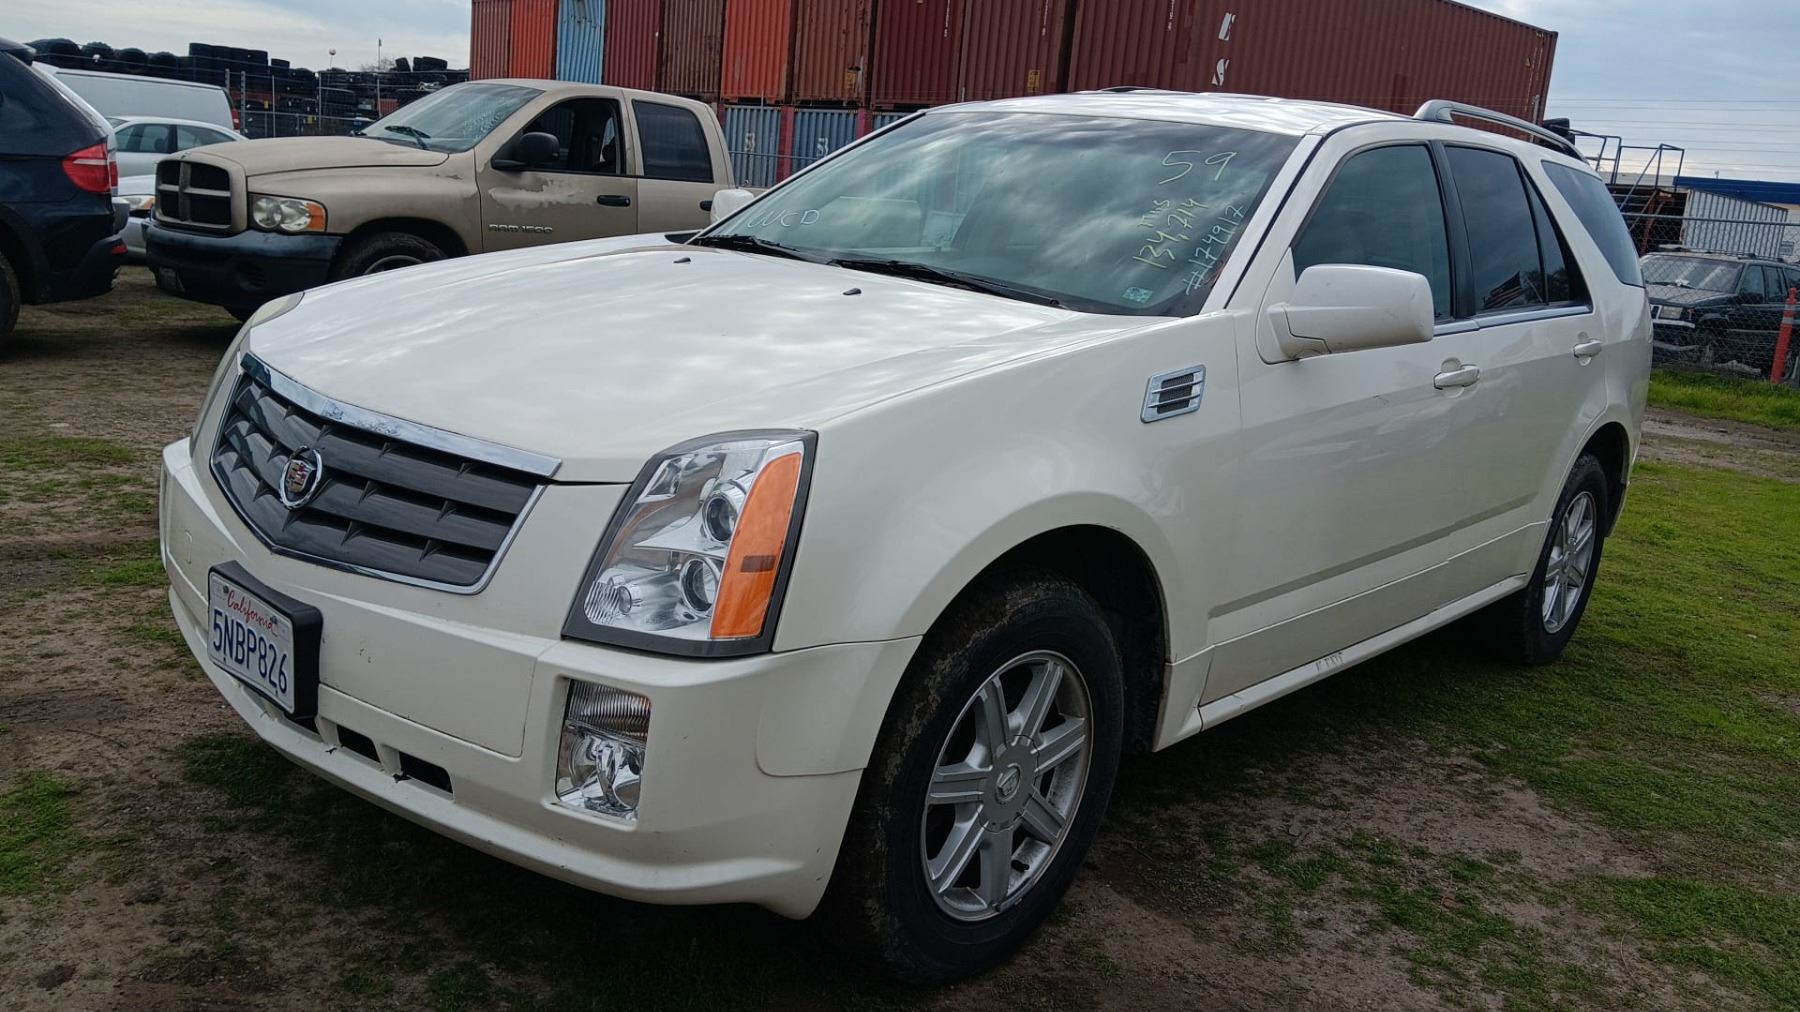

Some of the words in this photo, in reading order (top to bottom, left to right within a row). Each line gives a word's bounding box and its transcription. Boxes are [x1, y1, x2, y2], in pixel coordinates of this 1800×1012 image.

[1158, 150, 1237, 185] 59
[1182, 205, 1244, 296] #174917
[227, 590, 278, 637] California
[213, 609, 288, 695] 5NBP826
